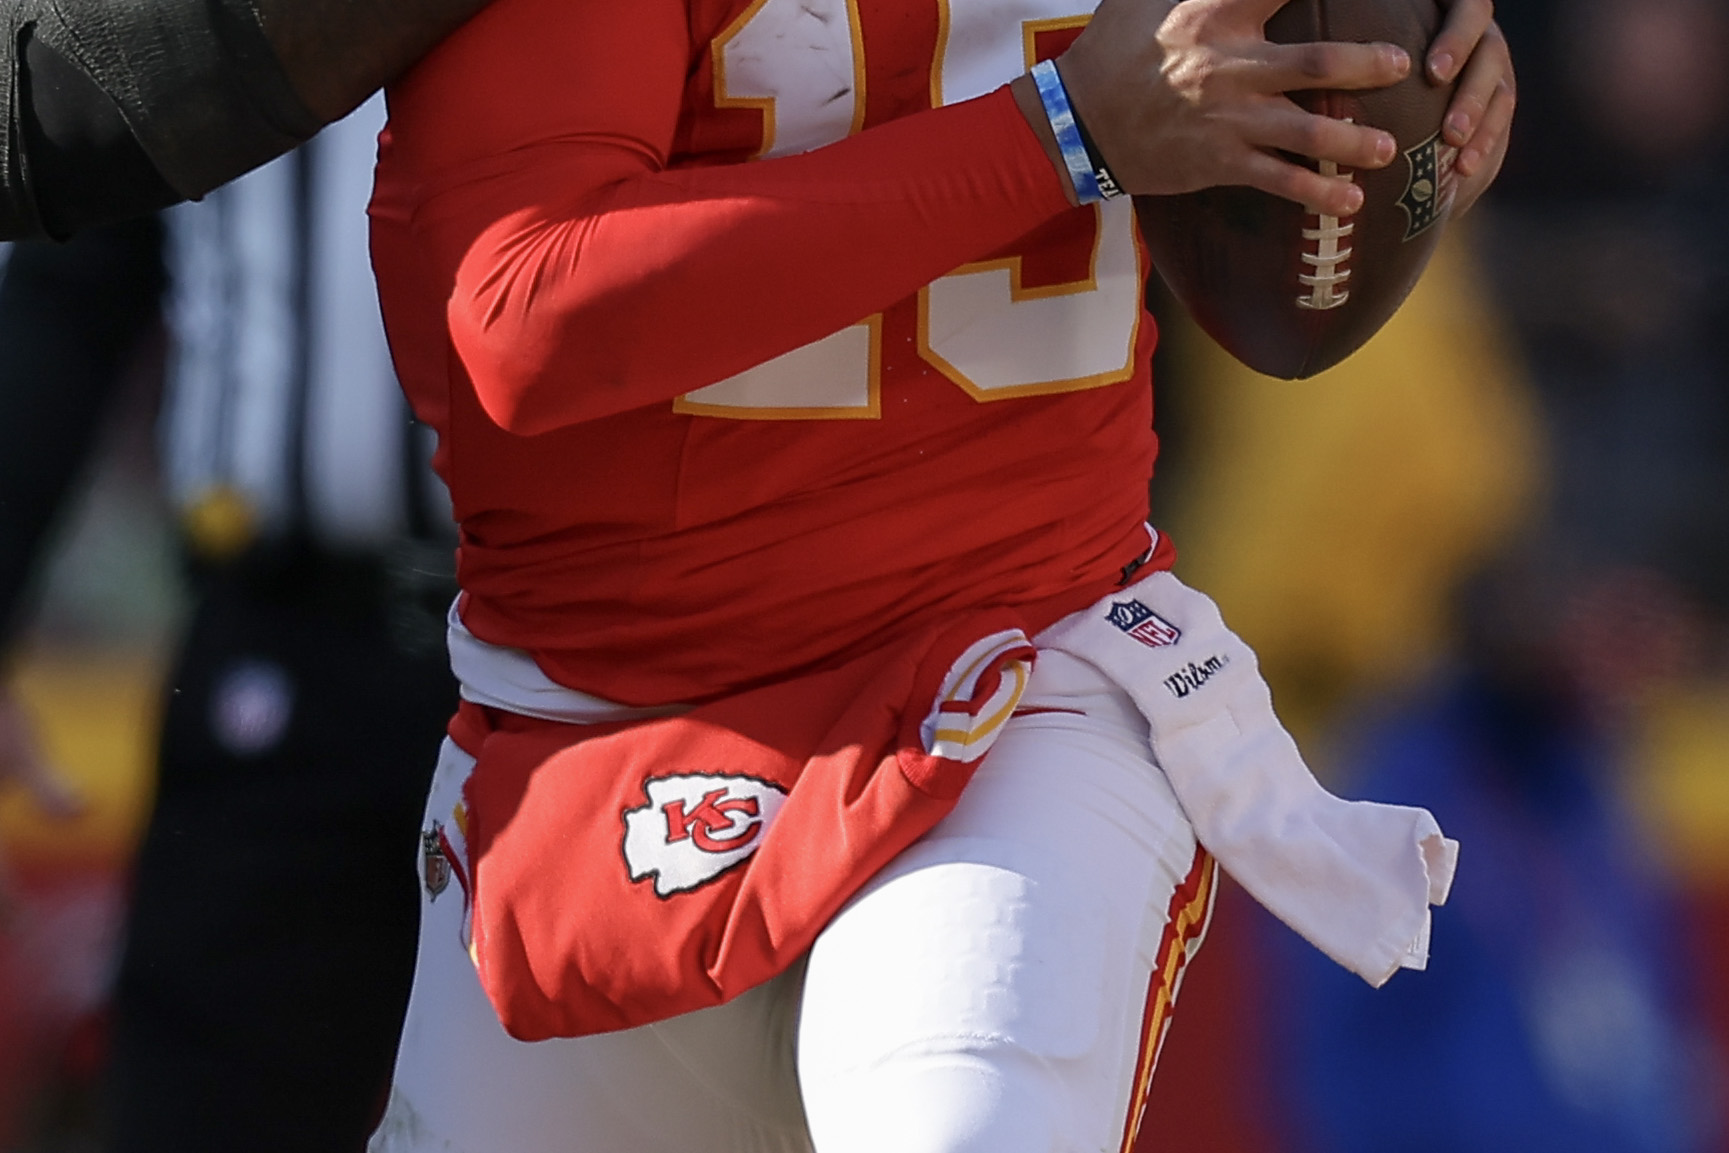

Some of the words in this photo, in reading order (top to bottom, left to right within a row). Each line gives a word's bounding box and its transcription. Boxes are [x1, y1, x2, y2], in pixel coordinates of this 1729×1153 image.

[1127, 619, 1176, 648] NFL
[1163, 655, 1222, 698] Wilson
[661, 787, 762, 854] KC
